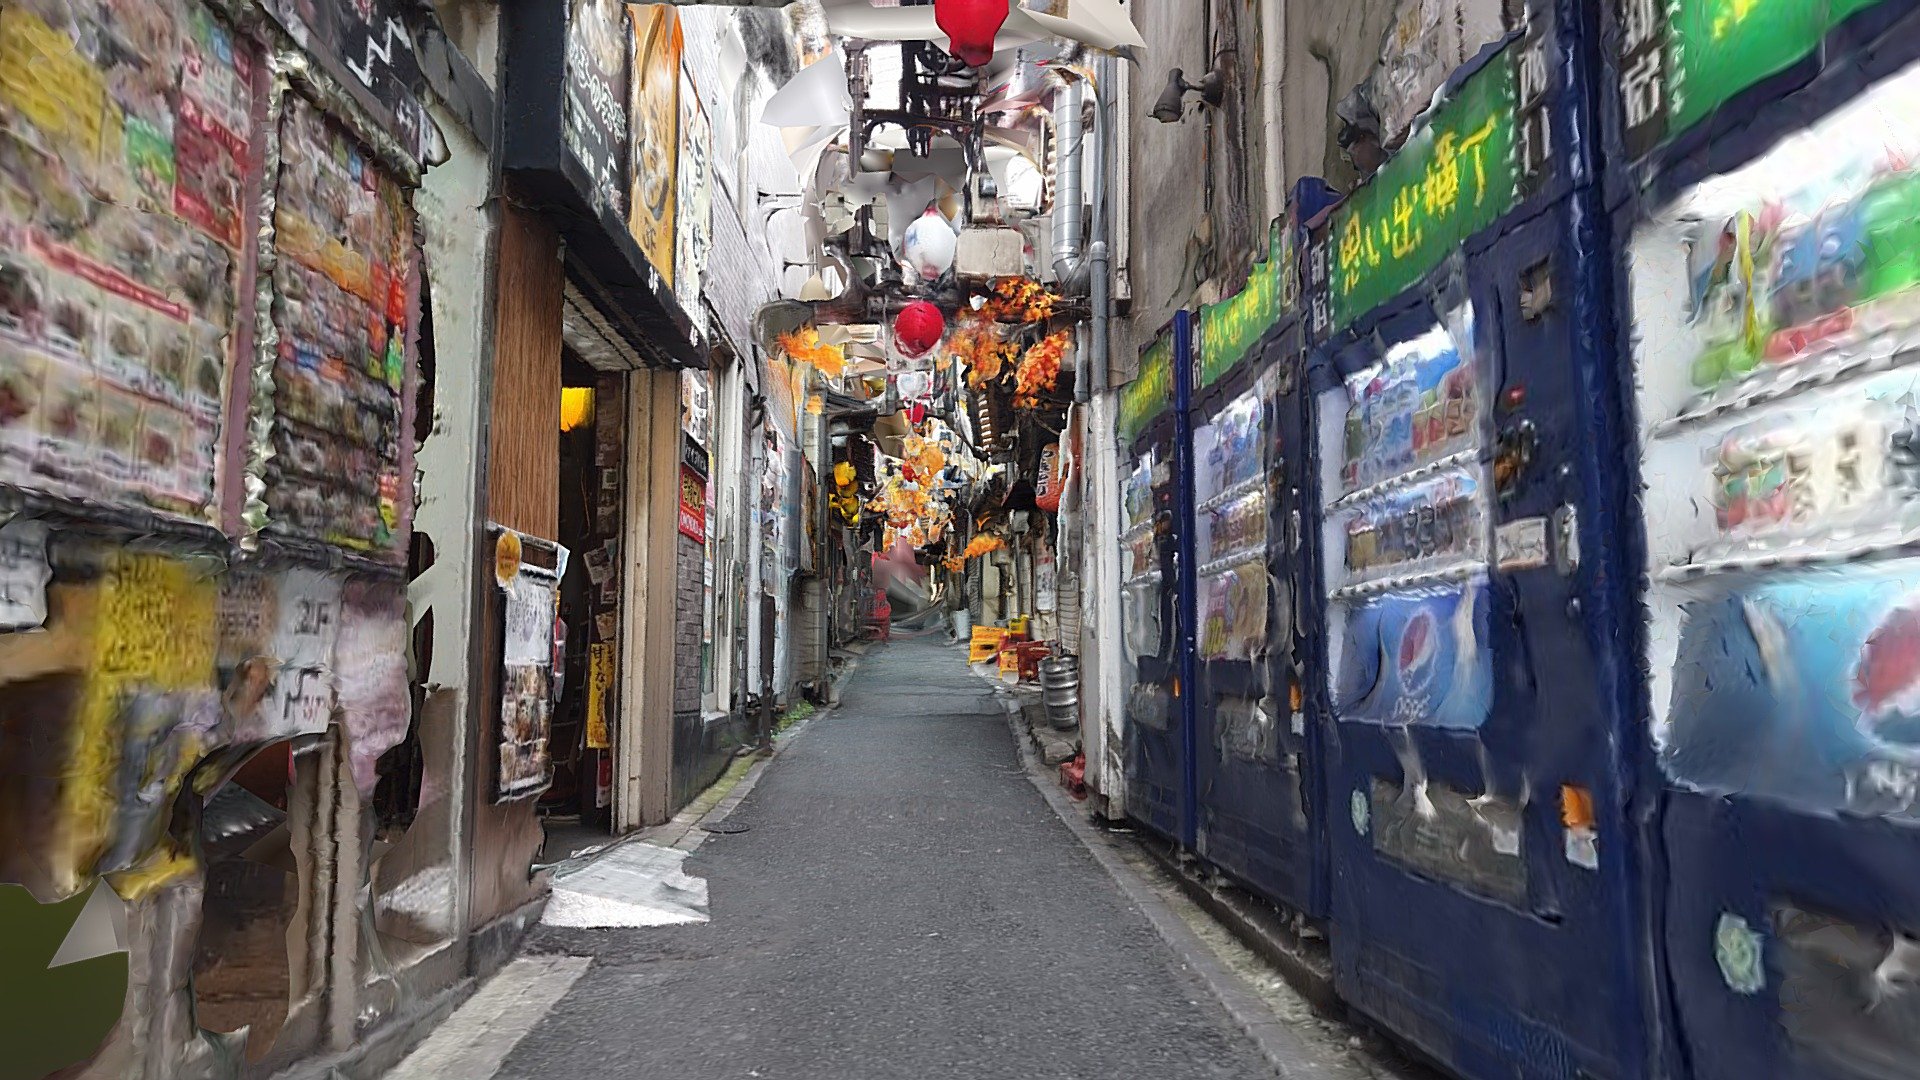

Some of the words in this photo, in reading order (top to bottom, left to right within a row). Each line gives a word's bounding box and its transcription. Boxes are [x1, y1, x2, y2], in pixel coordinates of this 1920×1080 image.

[1339, 114, 1497, 296] 思い出横丁
